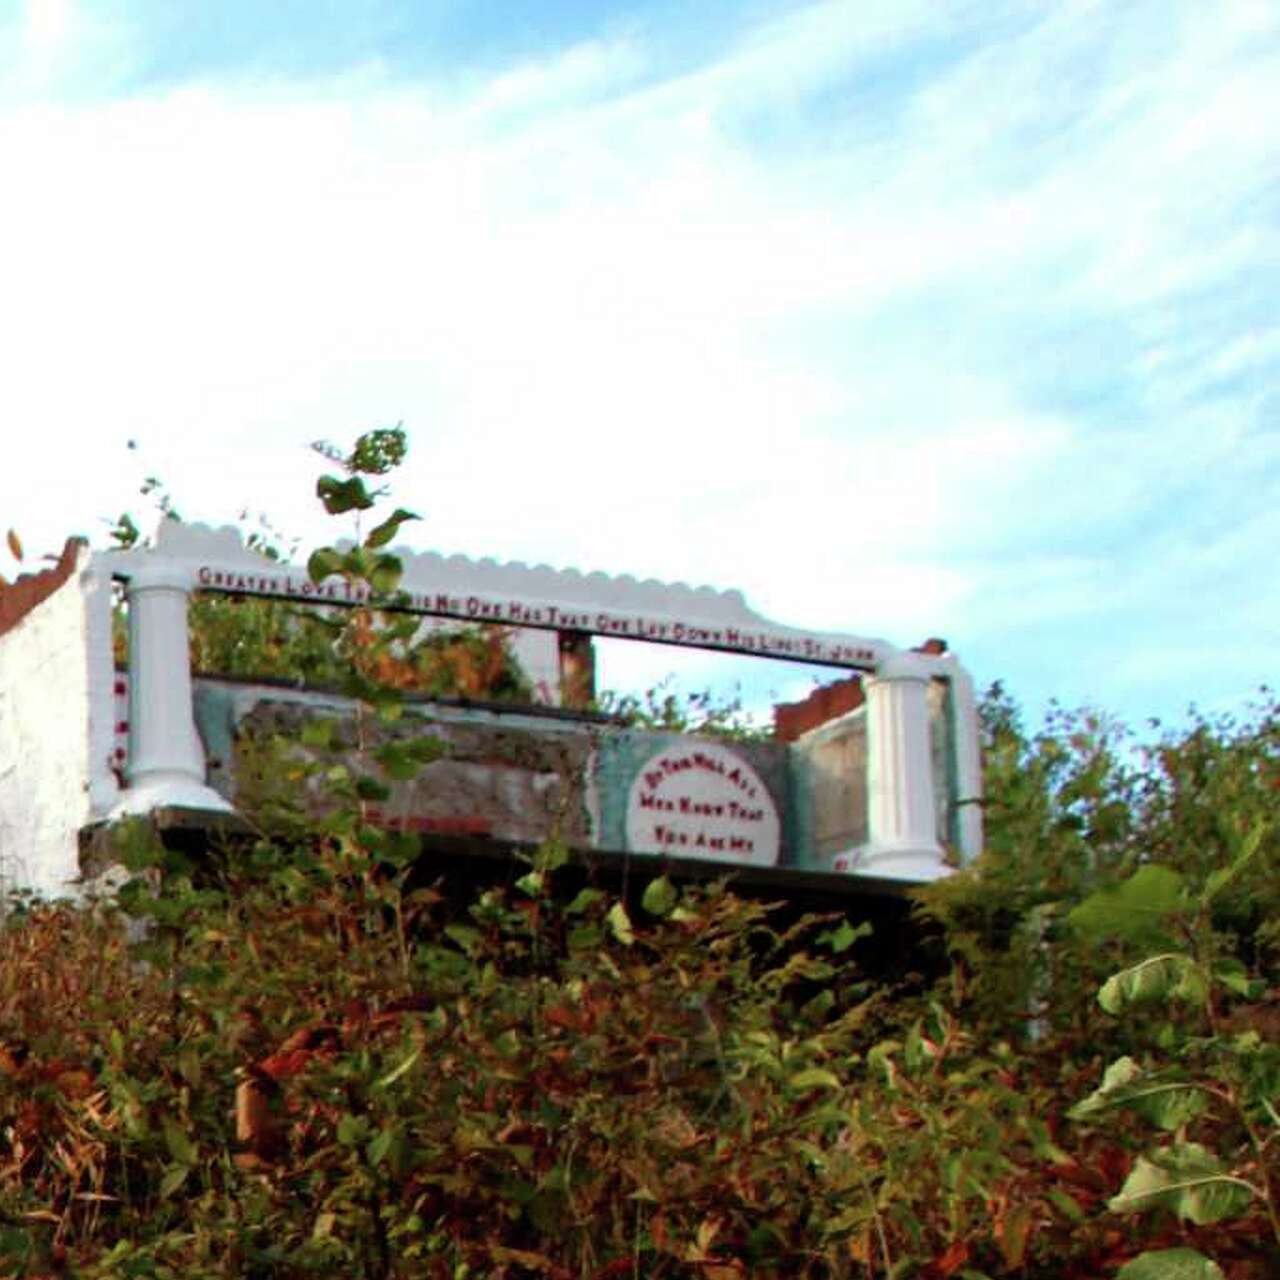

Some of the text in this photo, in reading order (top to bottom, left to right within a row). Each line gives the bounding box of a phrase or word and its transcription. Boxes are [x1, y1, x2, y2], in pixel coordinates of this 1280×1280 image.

[287, 576, 336, 596] LOVE
[468, 597, 501, 616] ONE
[509, 601, 541, 620] HAS
[547, 606, 589, 625] THAT
[673, 622, 721, 641] DOWN
[728, 768, 756, 798] ALL
[640, 792, 763, 821] MEN KNOW THAT
[654, 826, 754, 852] YOU ARE MY
